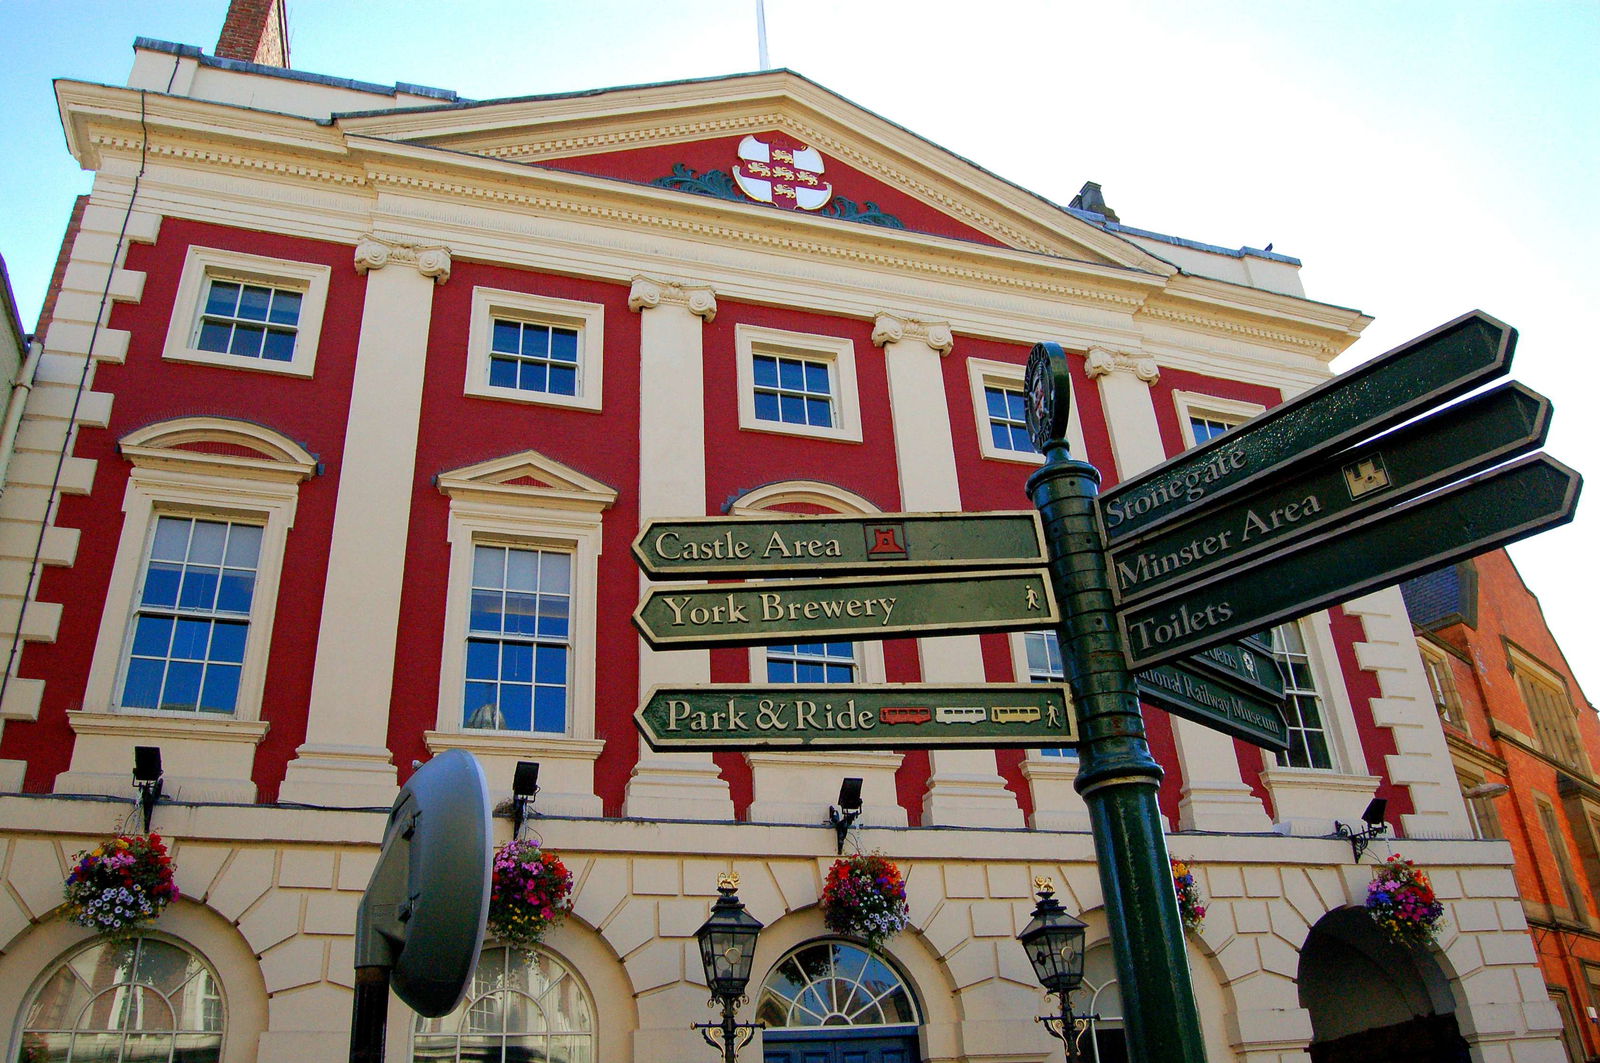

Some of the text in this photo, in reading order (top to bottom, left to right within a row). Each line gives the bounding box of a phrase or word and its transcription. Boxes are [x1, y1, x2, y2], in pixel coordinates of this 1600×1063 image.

[1104, 450, 1248, 529] Stonegate
[654, 530, 842, 561] Castle Area
[1115, 494, 1323, 590] Minster Area
[662, 591, 897, 626] York Brewery
[1129, 602, 1234, 651] Toilets
[666, 698, 876, 733] Park & Ride
[1133, 668, 1280, 734] ational Railway Museum
